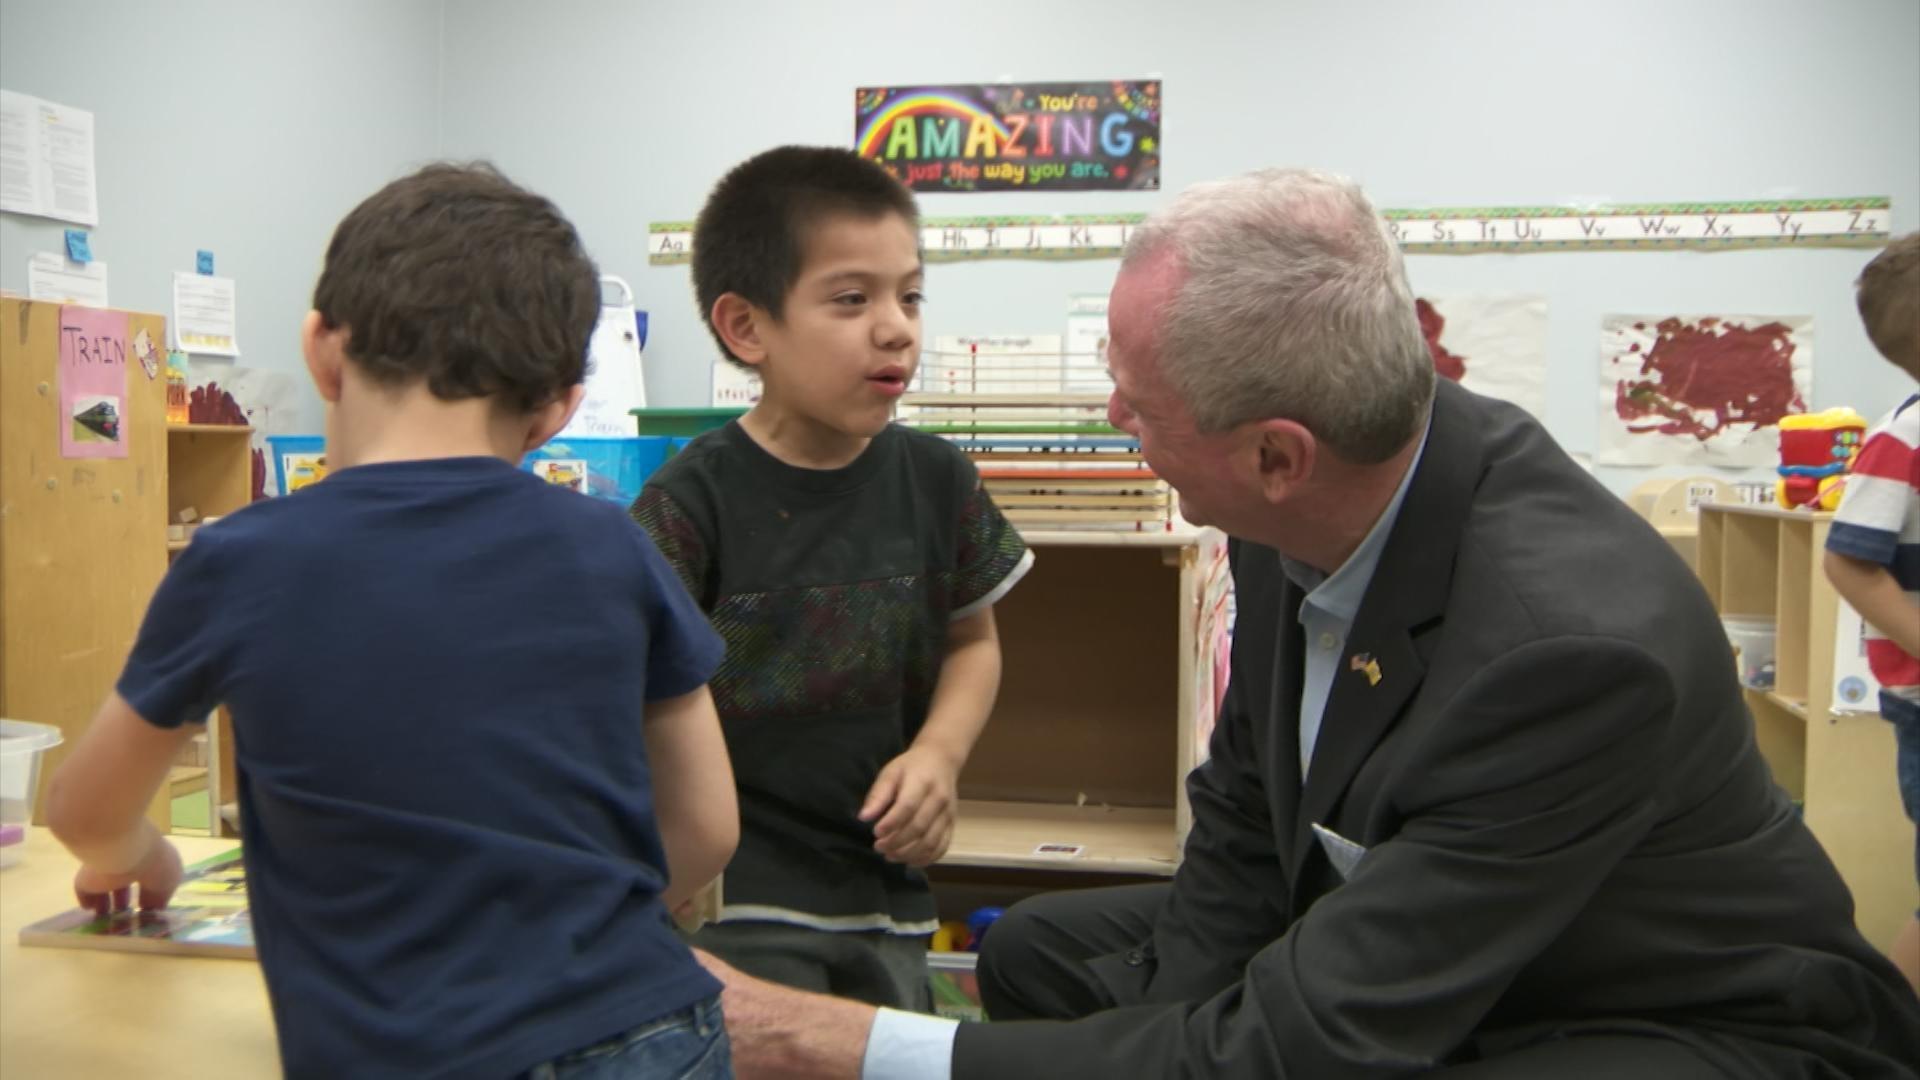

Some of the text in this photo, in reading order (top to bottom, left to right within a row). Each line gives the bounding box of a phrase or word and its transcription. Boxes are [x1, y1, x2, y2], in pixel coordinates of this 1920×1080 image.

[1040, 93, 1098, 112] You're
[886, 112, 1134, 159] AMAZING
[902, 161, 944, 187] just
[984, 162, 1026, 185] way
[1029, 162, 1066, 184] you
[659, 235, 684, 253] Aa
[942, 228, 968, 248] Hh
[1026, 228, 1042, 251] Jj
[1070, 226, 1092, 247] Kk
[1432, 220, 1455, 241] Ss
[1478, 220, 1497, 240] Tt
[1514, 220, 1542, 240] Uu
[1579, 217, 1606, 236] Vv
[1639, 217, 1681, 235] Ww
[1703, 215, 1733, 236] Xx
[1775, 214, 1803, 243] Yy
[1847, 210, 1878, 232] Zz
[63, 326, 126, 367] TRAIN
